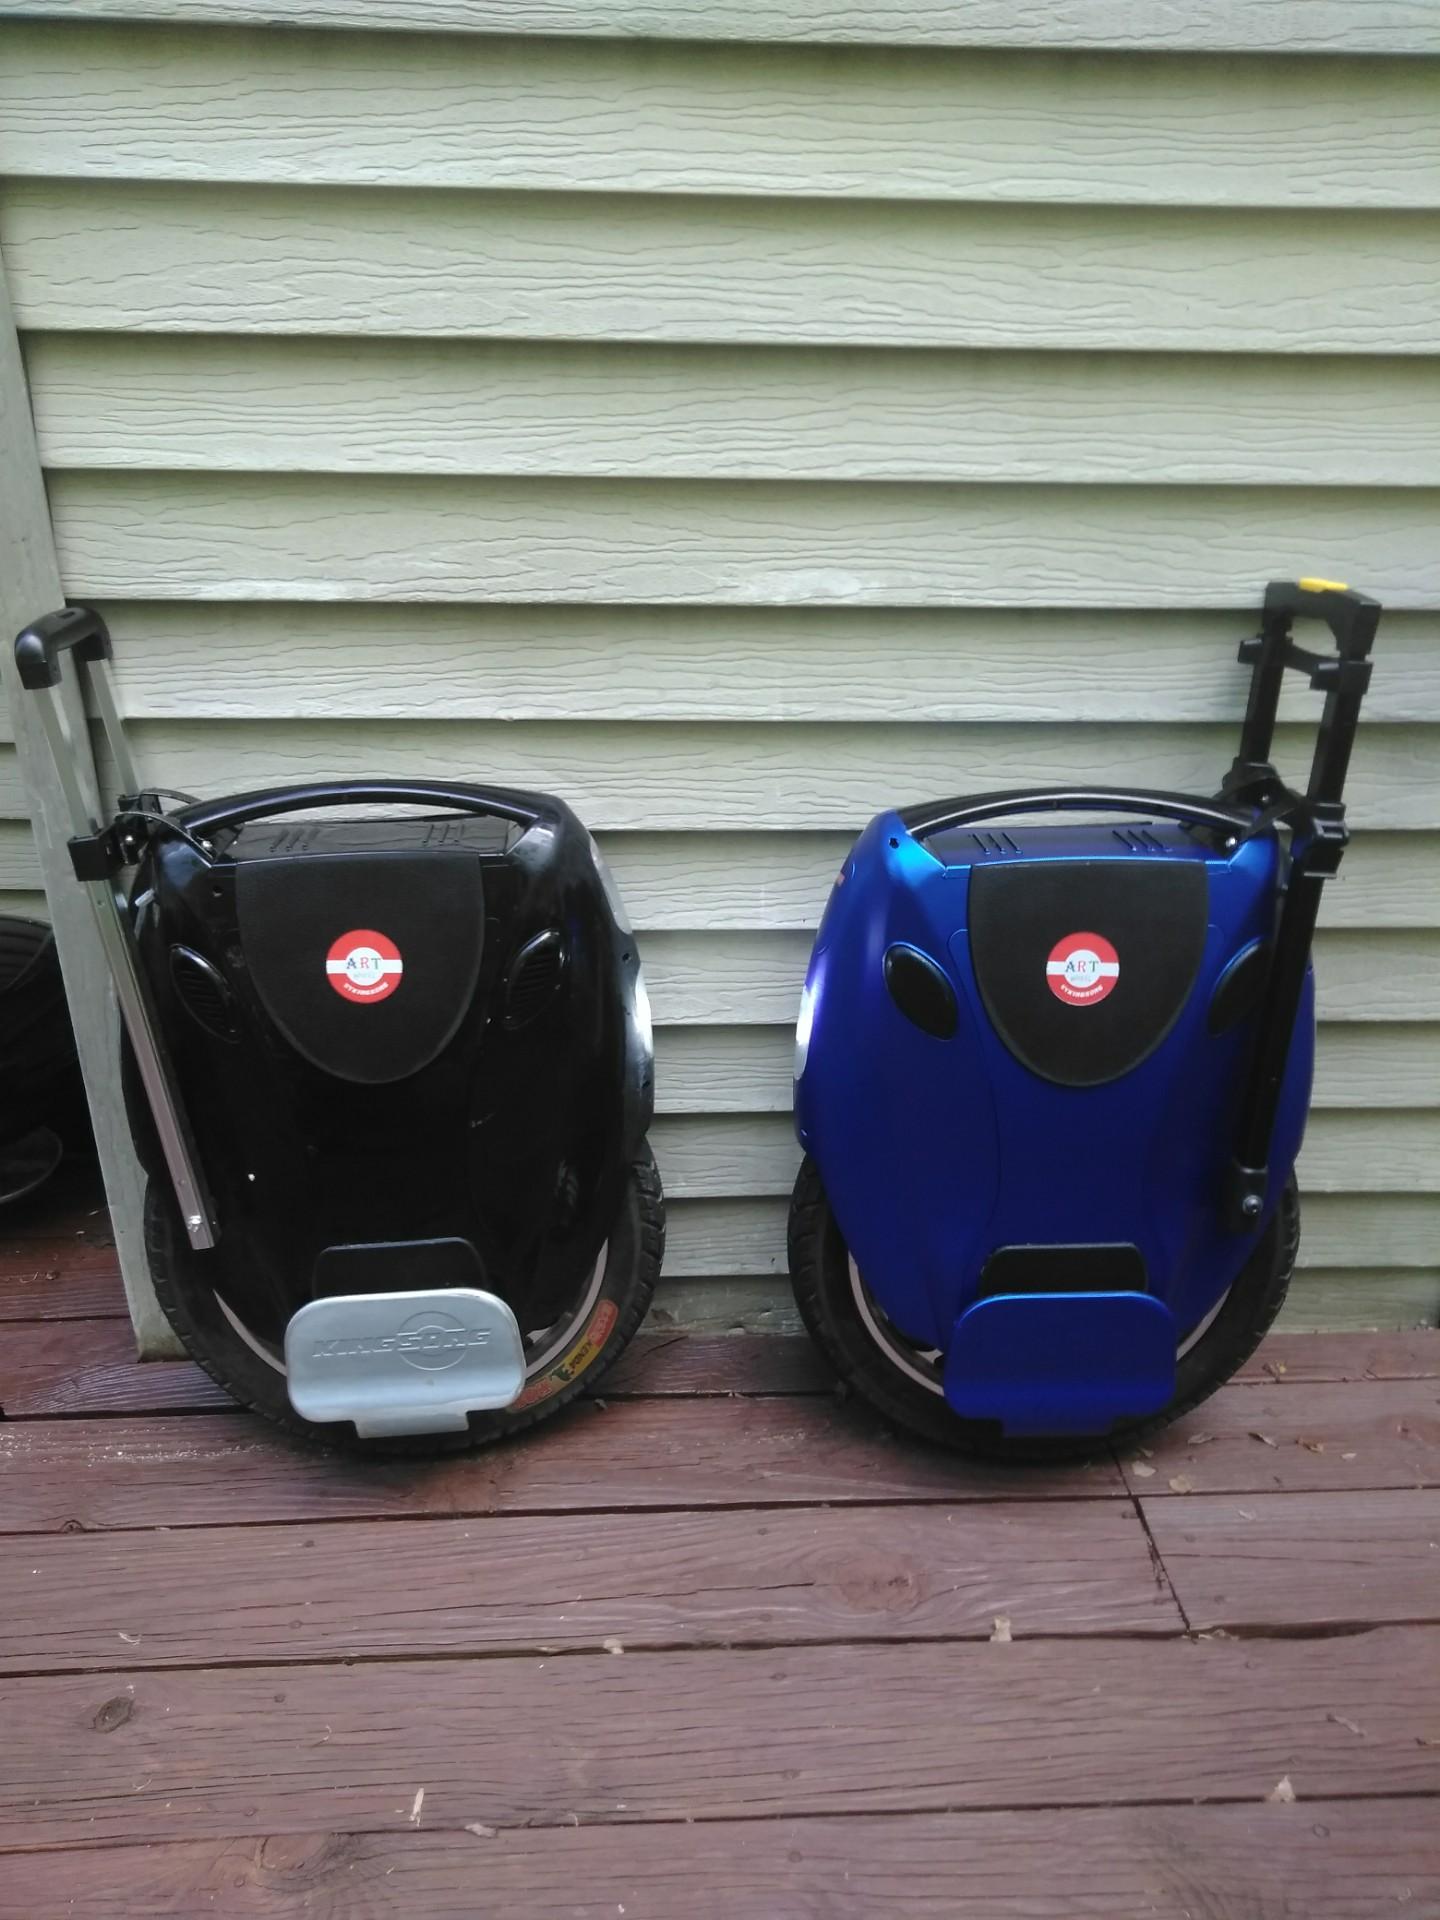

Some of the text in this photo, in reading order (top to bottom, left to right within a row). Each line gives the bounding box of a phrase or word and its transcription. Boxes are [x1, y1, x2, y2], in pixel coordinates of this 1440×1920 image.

[346, 957, 381, 969] ART
[1065, 960, 1099, 973] ART
[312, 1327, 492, 1358] KINGSONG
